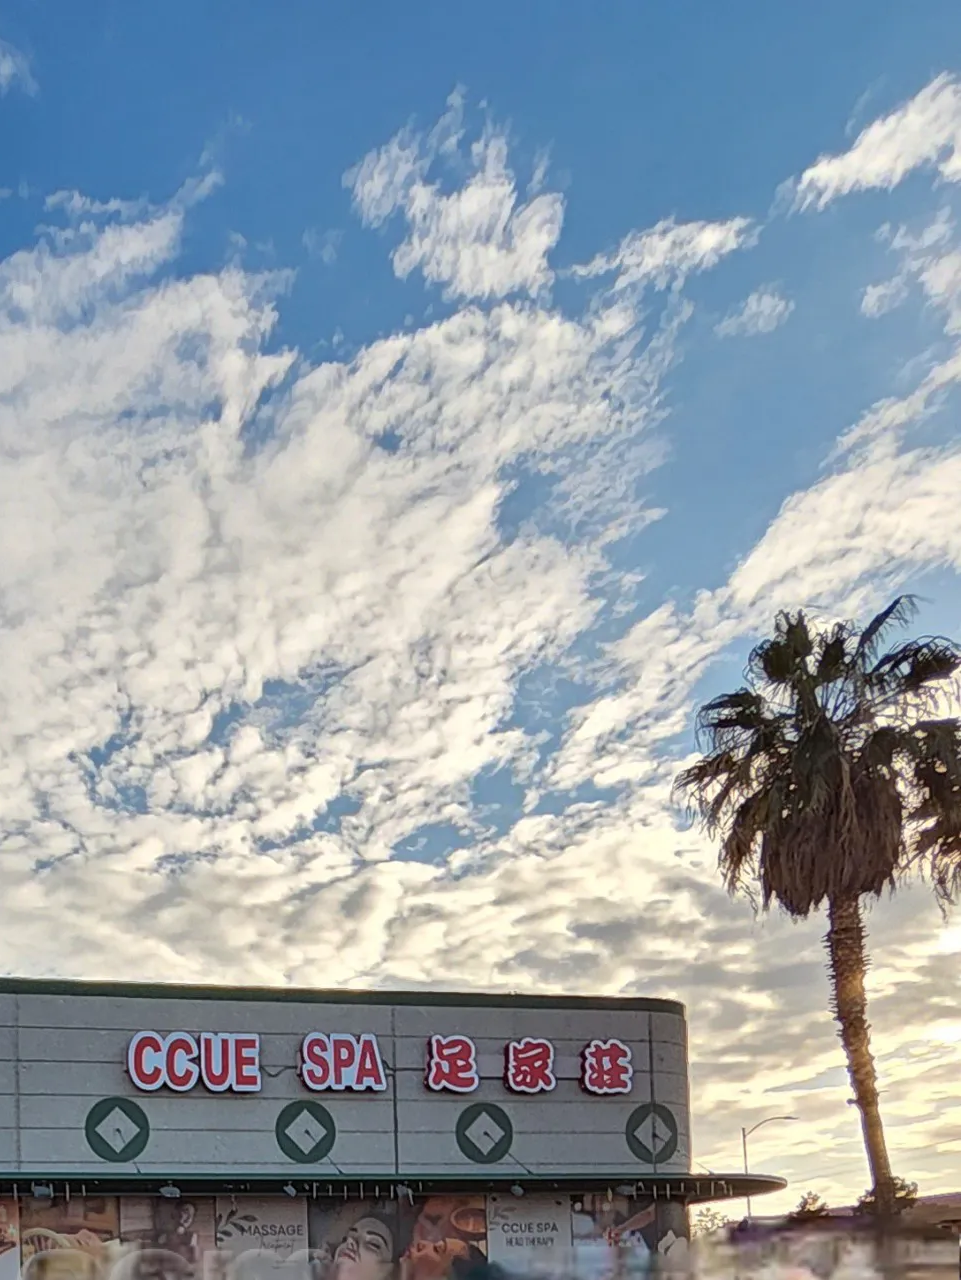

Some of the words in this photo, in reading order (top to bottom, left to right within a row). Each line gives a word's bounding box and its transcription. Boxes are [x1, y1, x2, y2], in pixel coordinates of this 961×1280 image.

[129, 1031, 262, 1092] CCUE
[303, 1032, 387, 1091] SPA
[241, 1224, 304, 1236] MASSAGE
[501, 1222, 534, 1233] CCUE
[536, 1222, 559, 1233] SPA
